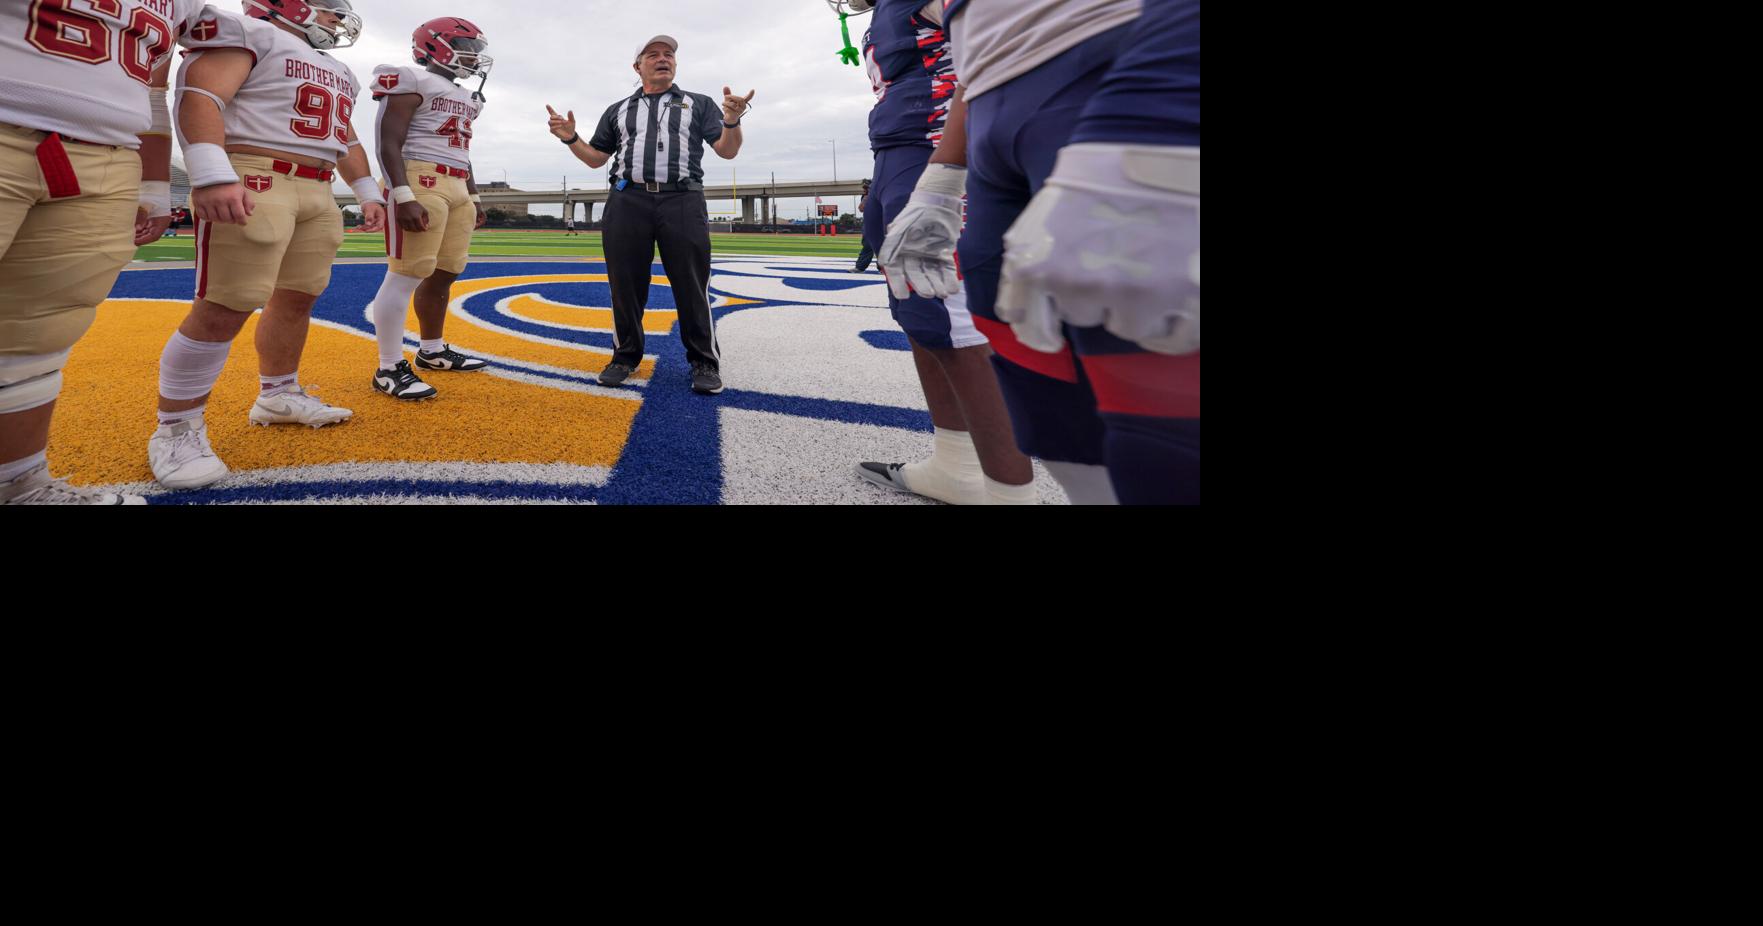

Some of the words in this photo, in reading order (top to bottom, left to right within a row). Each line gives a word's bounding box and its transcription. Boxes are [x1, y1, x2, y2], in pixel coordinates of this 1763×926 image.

[25, 0, 174, 85] 60
[285, 58, 335, 89] BROTHER
[289, 81, 353, 145] 99
[431, 97, 466, 115] BROTHER
